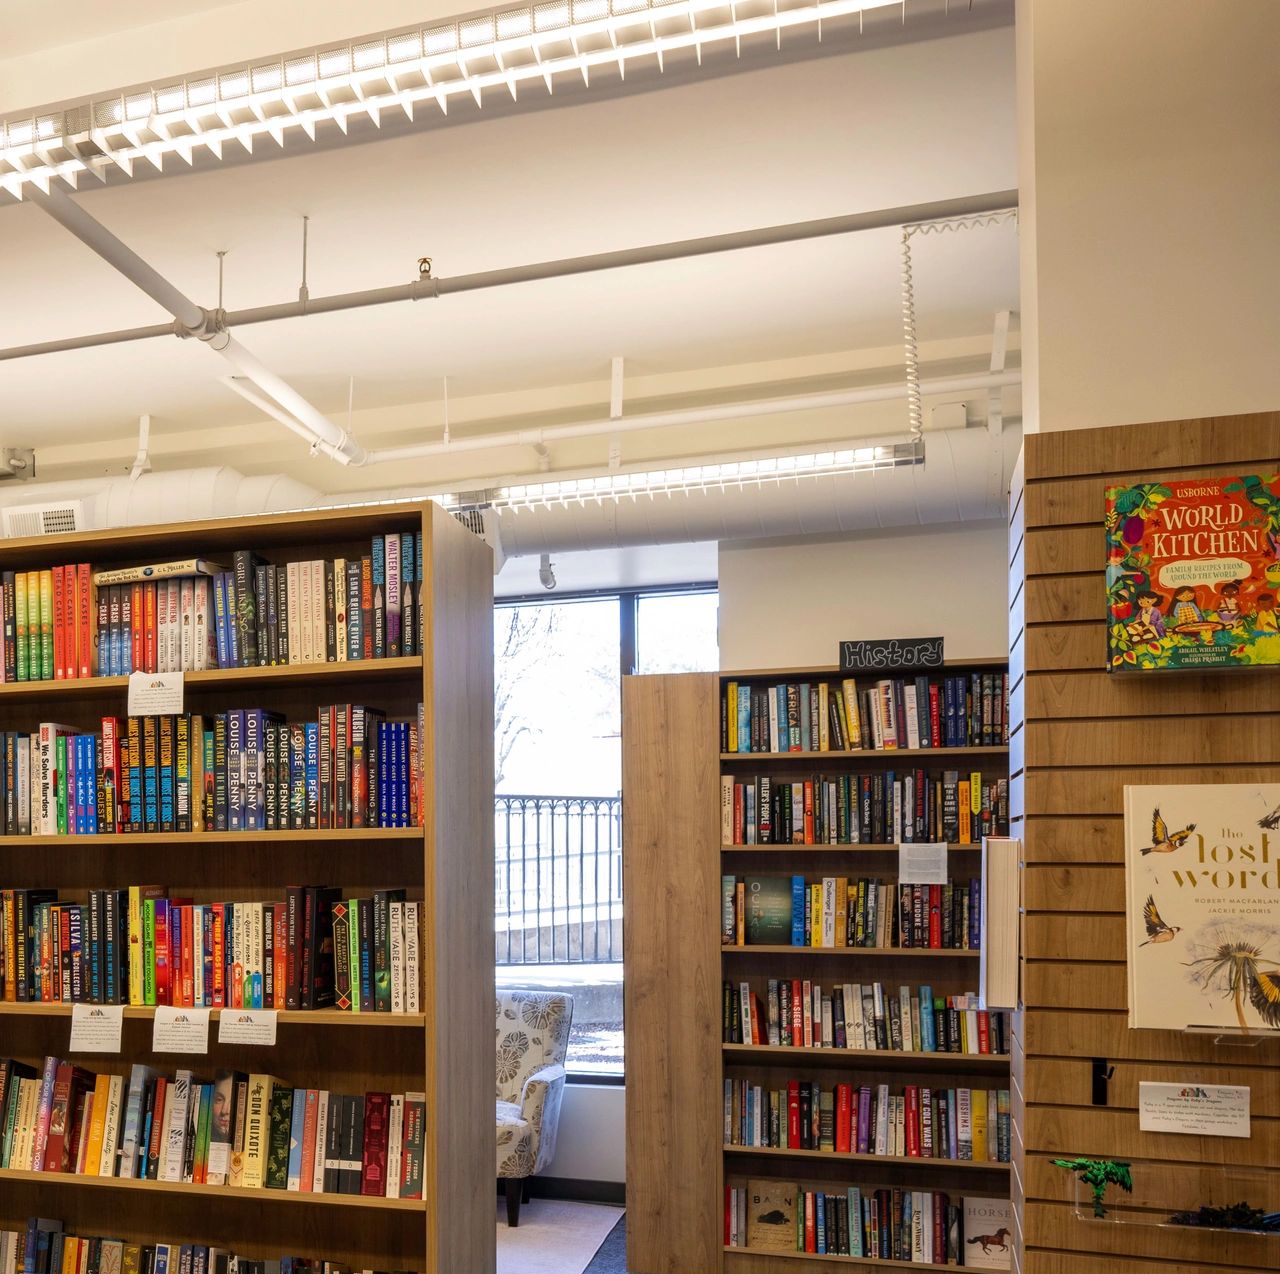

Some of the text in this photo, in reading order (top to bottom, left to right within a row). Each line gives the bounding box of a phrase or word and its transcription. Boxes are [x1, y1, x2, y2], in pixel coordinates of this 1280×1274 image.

[1176, 487, 1219, 499] USBORNE
[1160, 503, 1243, 530] WORLD
[1152, 530, 1259, 558] KITCHEN
[388, 540, 398, 605] WALTER MOSLEY
[1166, 562, 1243, 575] FAMILY RECIPES FROM
[1170, 573, 1197, 582] AROUND
[1213, 571, 1237, 579] WORLD
[55, 572, 63, 628] HEAD CASES
[110, 604, 118, 622] CRASH
[122, 602, 130, 622] CRASH
[350, 577, 359, 649] LONG BRIGHT RIVER
[845, 640, 944, 668] History
[177, 718, 188, 816] JAMES PATTERSON PARANOIA
[230, 714, 239, 811] LOUISE PENNY
[248, 713, 256, 811] LOUISE PENNY
[280, 728, 288, 816] LOUISE PENNY
[294, 731, 302, 814] LOUISE PENNY
[308, 729, 316, 813] LOUISE PENNY
[41, 745, 49, 819] We Solve Murders
[761, 777, 770, 824] HITLER'S PEOPLE
[1221, 828, 1244, 838] the
[1196, 833, 1271, 864] lost
[1195, 897, 1226, 905] ROBERT
[391, 907, 399, 935] RUTH
[407, 907, 415, 934] RUTH
[408, 936, 416, 962] WARE
[923, 1107, 931, 1124] COLD
[960, 1090, 968, 1128] HIROSHIMA
[248, 1097, 261, 1158] DON QUIXOTE
[924, 1127, 932, 1147] WARS
